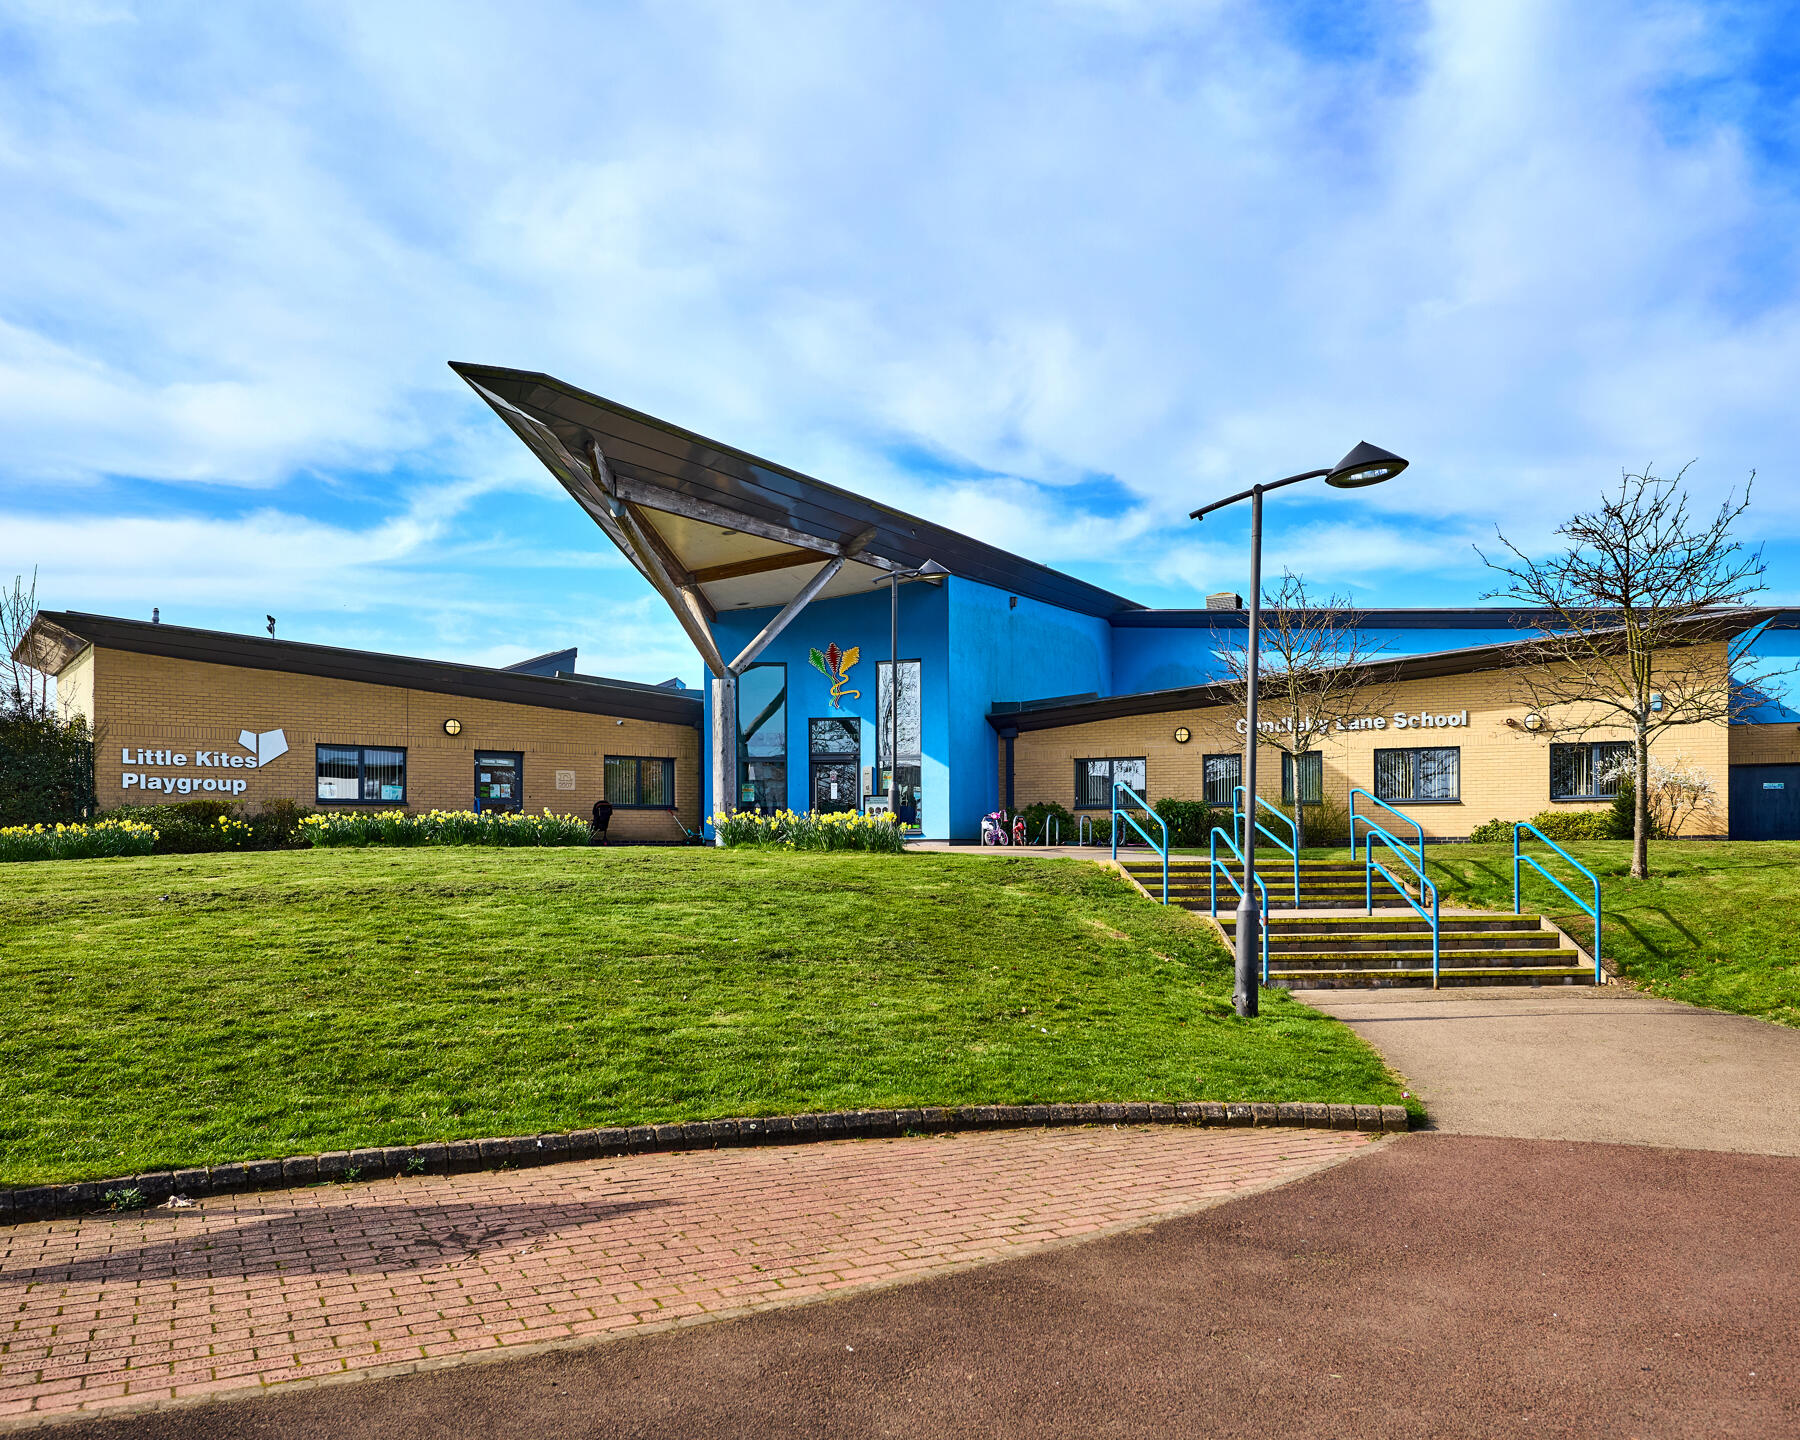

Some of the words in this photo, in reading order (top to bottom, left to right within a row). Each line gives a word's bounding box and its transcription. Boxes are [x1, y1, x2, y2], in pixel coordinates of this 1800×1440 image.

[1336, 714, 1386, 730] Lane
[1393, 710, 1467, 729] School
[122, 748, 188, 766] Little
[195, 751, 258, 769] Kites
[122, 773, 247, 796] Playgroup
